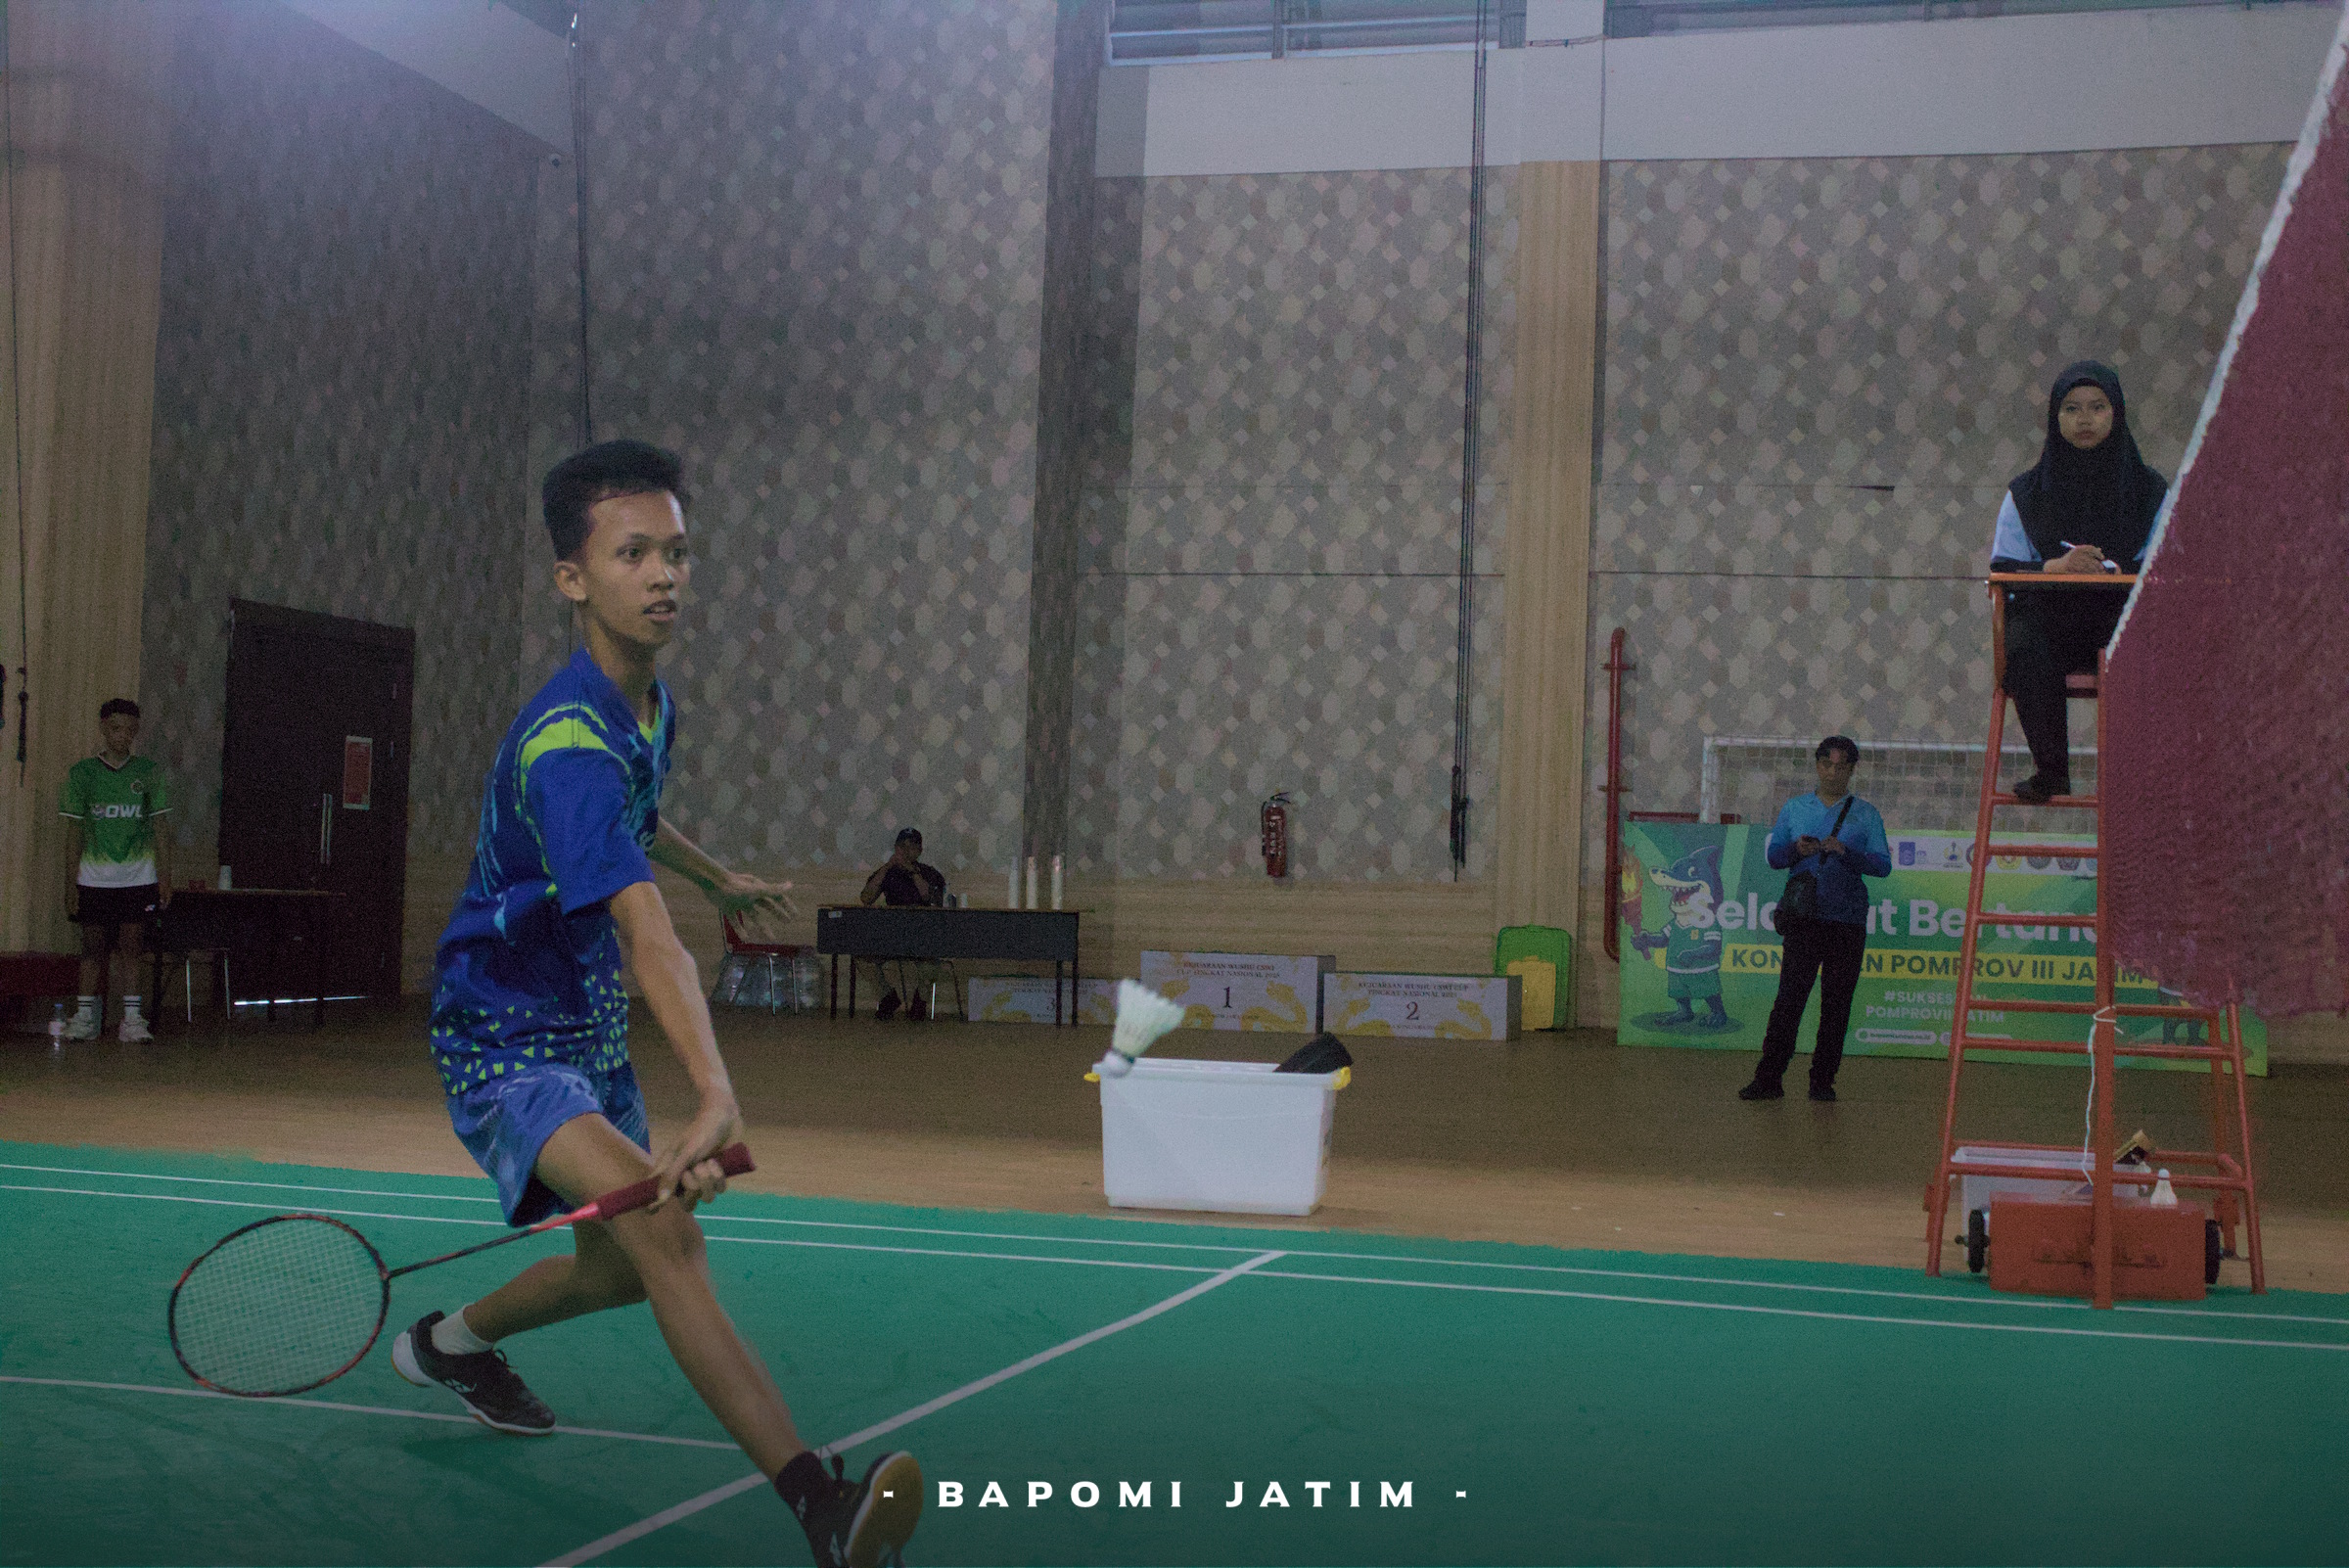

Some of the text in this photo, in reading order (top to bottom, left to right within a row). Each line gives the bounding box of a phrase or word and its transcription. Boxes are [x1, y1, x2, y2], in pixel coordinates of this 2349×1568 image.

[2031, 959, 2053, 980] III
[1222, 987, 1233, 1008] 1
[1406, 1001, 1419, 1020] 2
